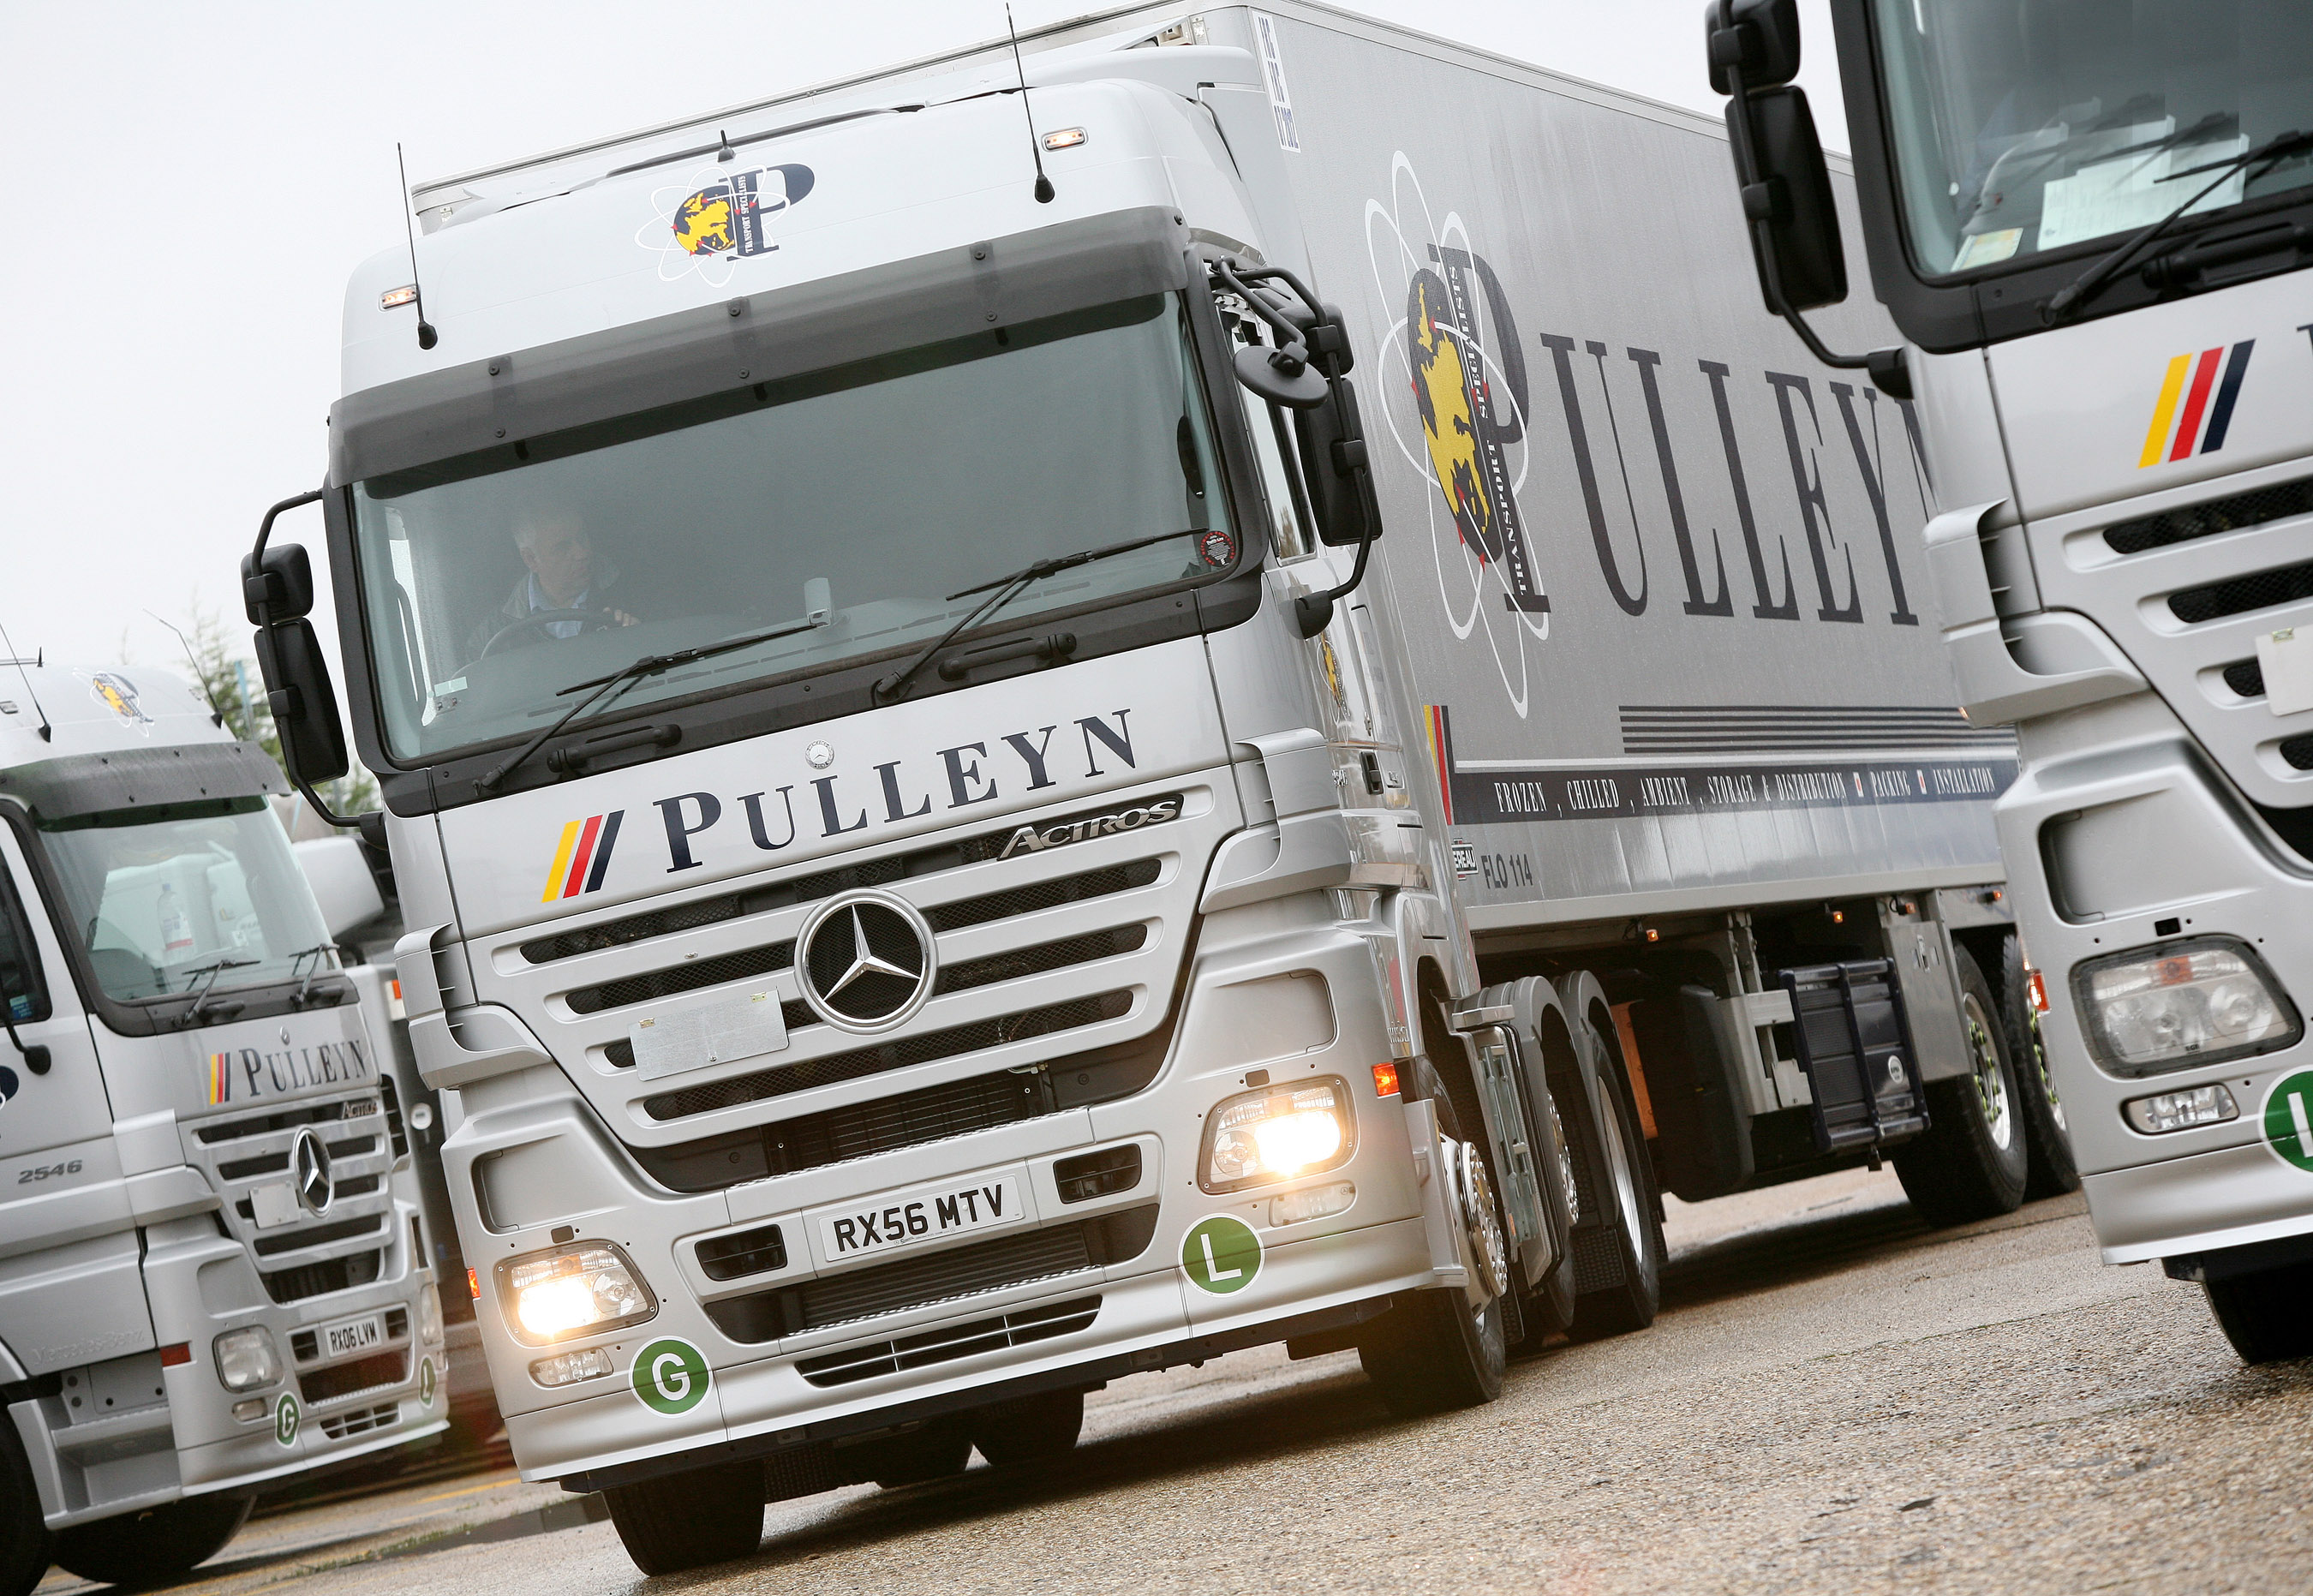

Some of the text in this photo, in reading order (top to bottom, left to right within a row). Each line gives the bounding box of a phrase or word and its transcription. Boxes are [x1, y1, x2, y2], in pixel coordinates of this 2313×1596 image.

[741, 216, 754, 254] TRANSPORT
[1449, 266, 1527, 595] TRANSPORT SPECILISTS
[653, 708, 1137, 873] PULLEYN
[1707, 774, 1757, 804] STORAGE
[1775, 772, 1847, 801] DISTRIBUTION
[1870, 770, 1911, 798] PACKING
[1933, 767, 1996, 796] INSTALLATION
[1481, 853, 1533, 889] FLO 114
[238, 1035, 367, 1097] PULLEYN
[18, 1159, 83, 1184] 2546
[834, 1184, 1002, 1252] RX56 MTV
[1200, 1233, 1242, 1282] L
[330, 1321, 377, 1352] RX06 LVM
[652, 1353, 691, 1401] G
[282, 1402, 296, 1438] G
